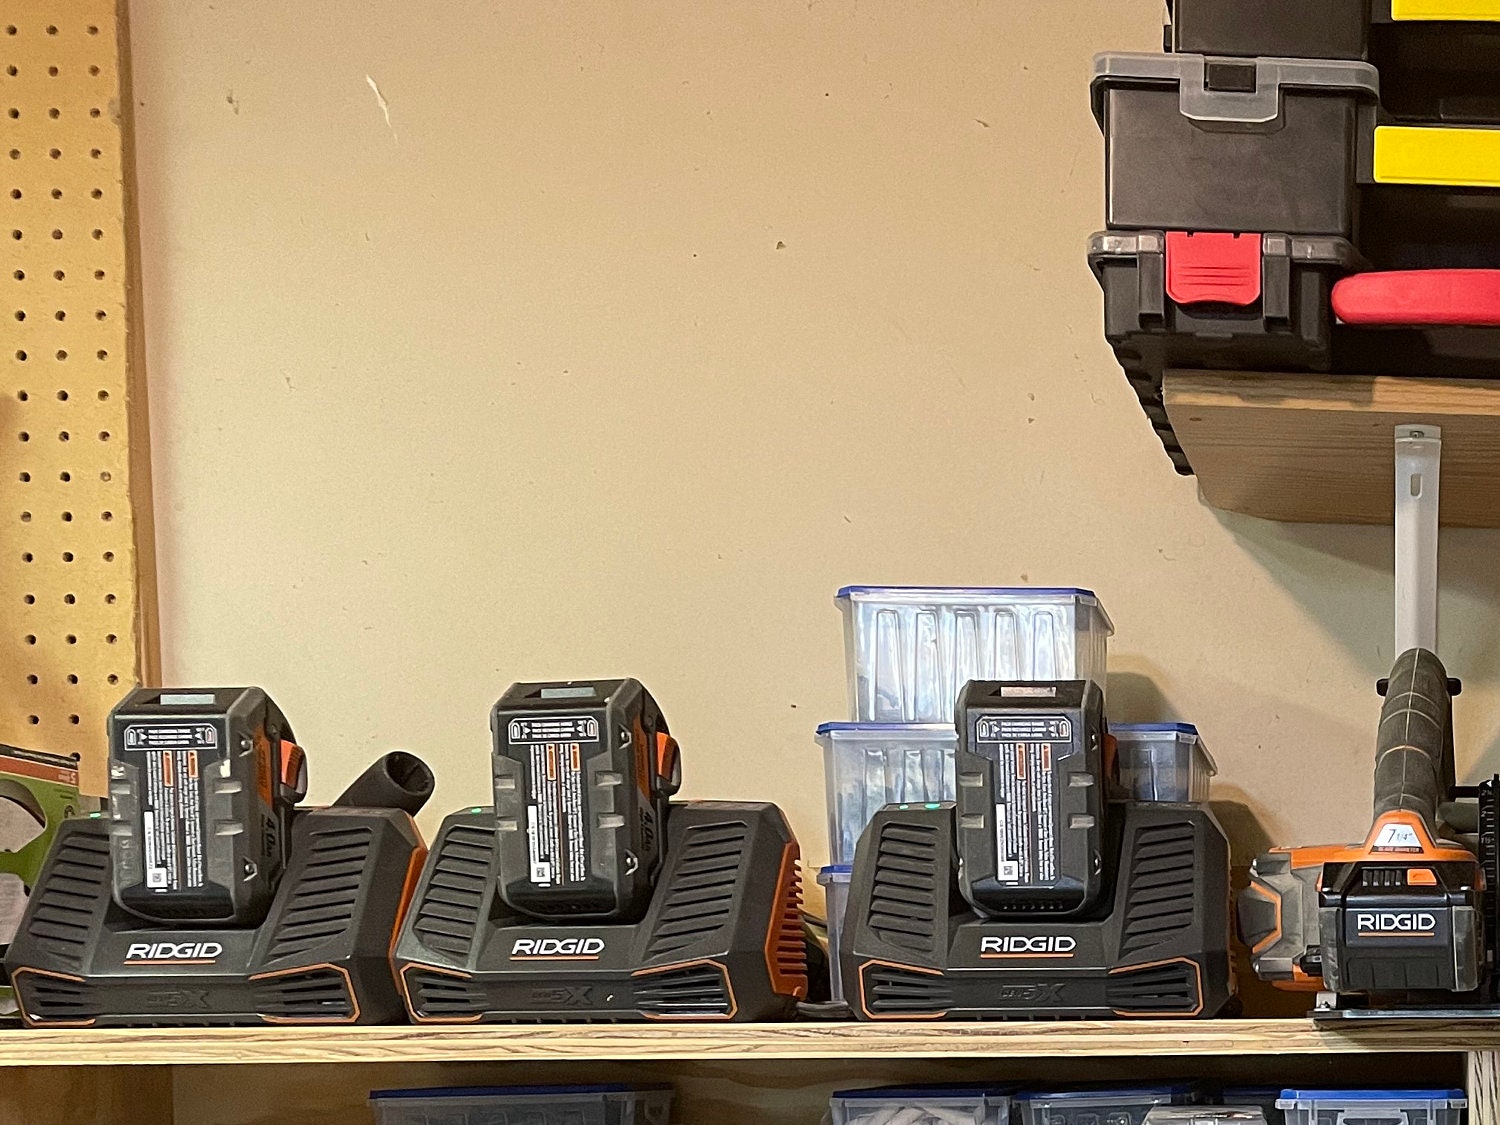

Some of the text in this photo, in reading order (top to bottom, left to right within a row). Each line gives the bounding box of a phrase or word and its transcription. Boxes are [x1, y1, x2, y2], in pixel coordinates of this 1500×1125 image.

[1357, 913, 1436, 931] RIDGID
[125, 942, 223, 959] RIDGID
[511, 938, 605, 955] RIDGID
[980, 936, 1077, 953] RIDGID
